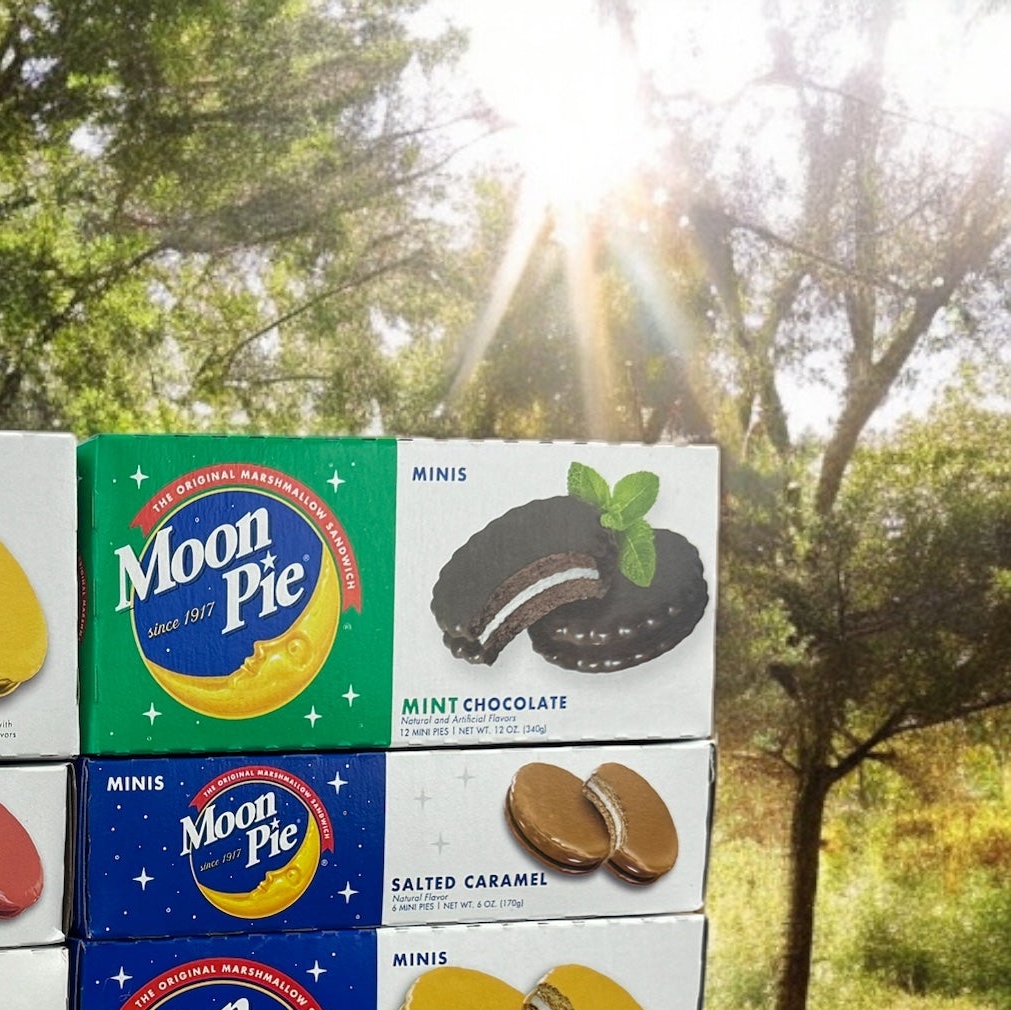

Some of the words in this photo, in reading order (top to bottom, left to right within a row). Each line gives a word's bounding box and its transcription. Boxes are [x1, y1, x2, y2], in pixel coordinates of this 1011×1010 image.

[412, 467, 467, 482] MINIS
[153, 493, 173, 514] THE
[177, 470, 235, 495] ORIGINAL
[241, 471, 326, 519] MARSHMALLOW
[325, 522, 356, 590] SANDWICH
[114, 507, 272, 612] Moon
[221, 551, 305, 635] Pie
[148, 618, 180, 638] since
[184, 601, 215, 625] 1917
[401, 716, 431, 725] Natural
[434, 715, 449, 724] and
[452, 714, 486, 723] Artificial
[489, 714, 516, 722] Flavors
[402, 697, 458, 715] MINT
[463, 695, 567, 712] CHOCOLATE
[106, 775, 164, 792] MINIS
[180, 791, 277, 856] Moon
[203, 784, 216, 798] THE
[218, 770, 254, 786] ORIGINAL
[257, 770, 312, 799] MARSHMALLOW
[310, 799, 330, 840] SANDWICH
[245, 818, 297, 868] Pie
[392, 876, 456, 892] SALTED
[465, 873, 547, 888] CARAMEL
[392, 951, 448, 967] MINIS
[134, 989, 155, 1008] THE
[158, 965, 216, 990] ORIGINAL
[222, 964, 308, 1006] MARSHMALLOW
